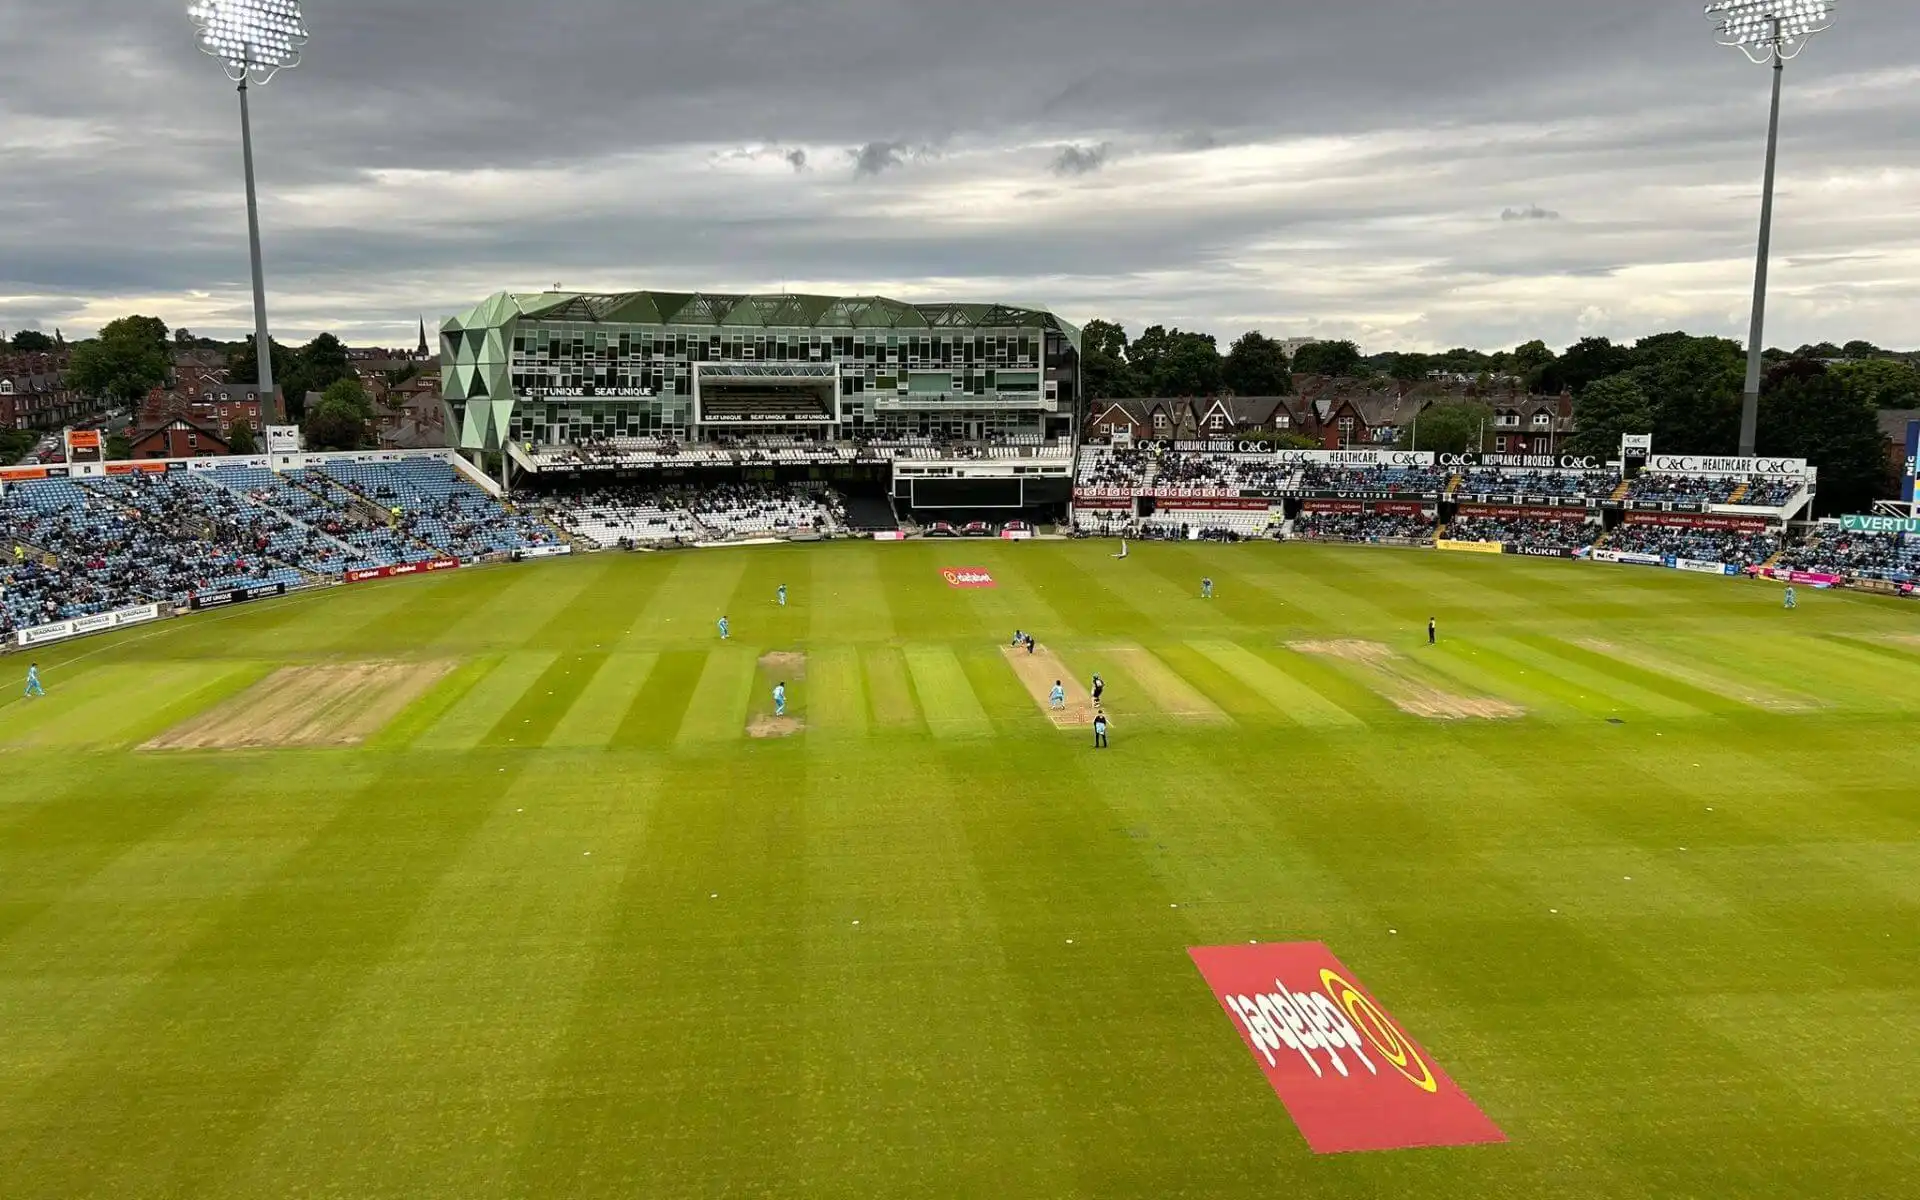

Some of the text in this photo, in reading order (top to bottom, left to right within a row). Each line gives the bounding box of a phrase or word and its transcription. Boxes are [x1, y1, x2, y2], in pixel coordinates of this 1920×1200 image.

[525, 387, 584, 397] ST UNIQUE
[594, 387, 652, 397] SEAT UNIQUE
[1138, 439, 1271, 453] C&C. INSURANCE BROKERS C&C.
[1282, 451, 1428, 465] C&C HEALTHCARE C&C.
[1439, 452, 1600, 469] C&C. INSURANCE BROKERS C&C.
[1656, 456, 1800, 474] C&C. HEALTHCARE C&C.
[1859, 516, 1917, 531] VERTU
[1525, 546, 1561, 556] KUKRI
[200, 593, 232, 604] SEAT UNIQUE
[1225, 977, 1378, 1078] dafabet
